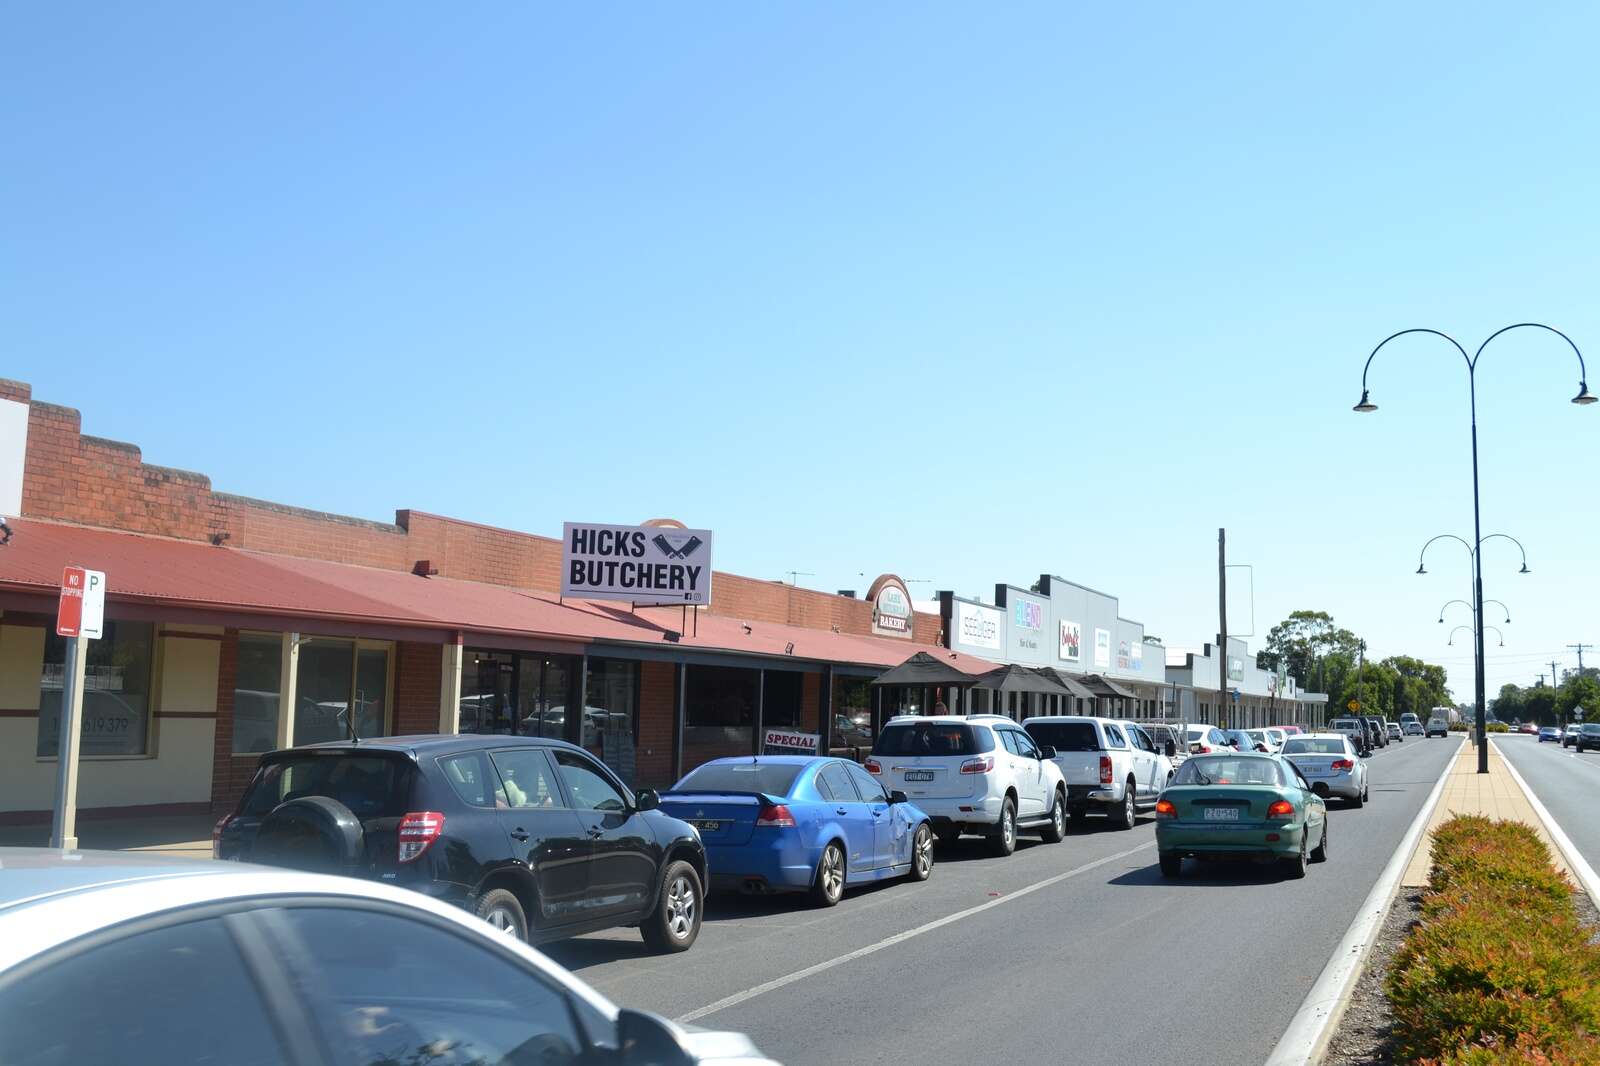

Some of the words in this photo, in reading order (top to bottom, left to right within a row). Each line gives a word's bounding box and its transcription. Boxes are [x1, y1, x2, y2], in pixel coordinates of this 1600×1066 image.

[571, 529, 646, 558] HICKS
[69, 575, 79, 586] NO
[90, 576, 99, 591] P
[570, 560, 702, 591] BUTCHERY
[62, 587, 84, 599] STOPPING
[879, 615, 906, 631] BAKERY
[766, 733, 817, 749] SPECIAL
